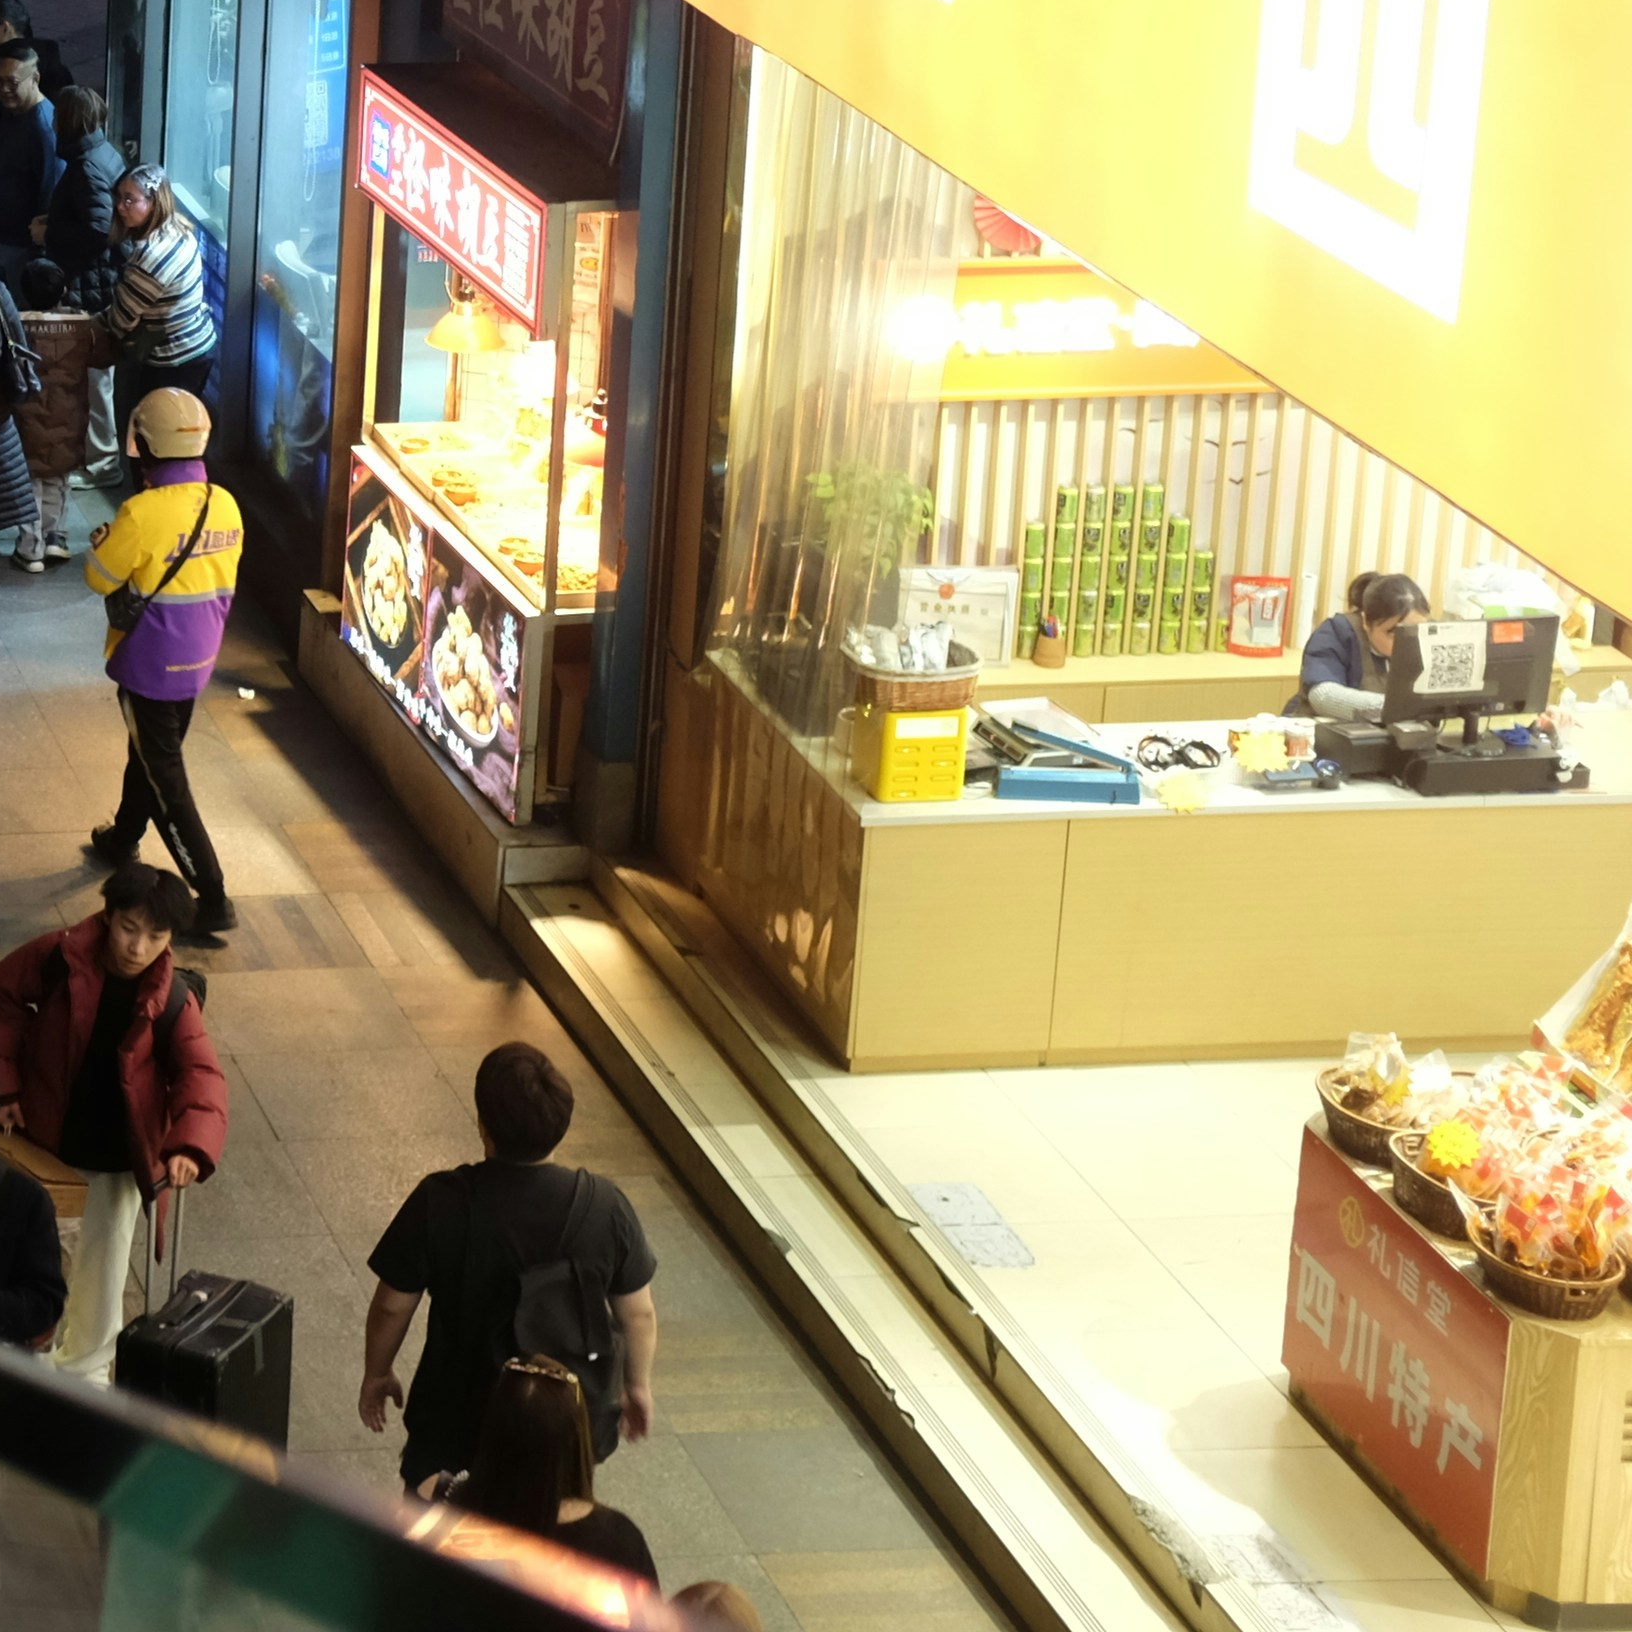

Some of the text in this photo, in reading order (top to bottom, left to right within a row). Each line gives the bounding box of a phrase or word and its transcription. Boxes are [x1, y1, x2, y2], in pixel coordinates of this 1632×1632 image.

[388, 122, 406, 202] 手工
[403, 126, 504, 279] 怪味胡豆
[1366, 1223, 1455, 1338] 礼信堂
[1293, 1244, 1489, 1478] 四川特产
